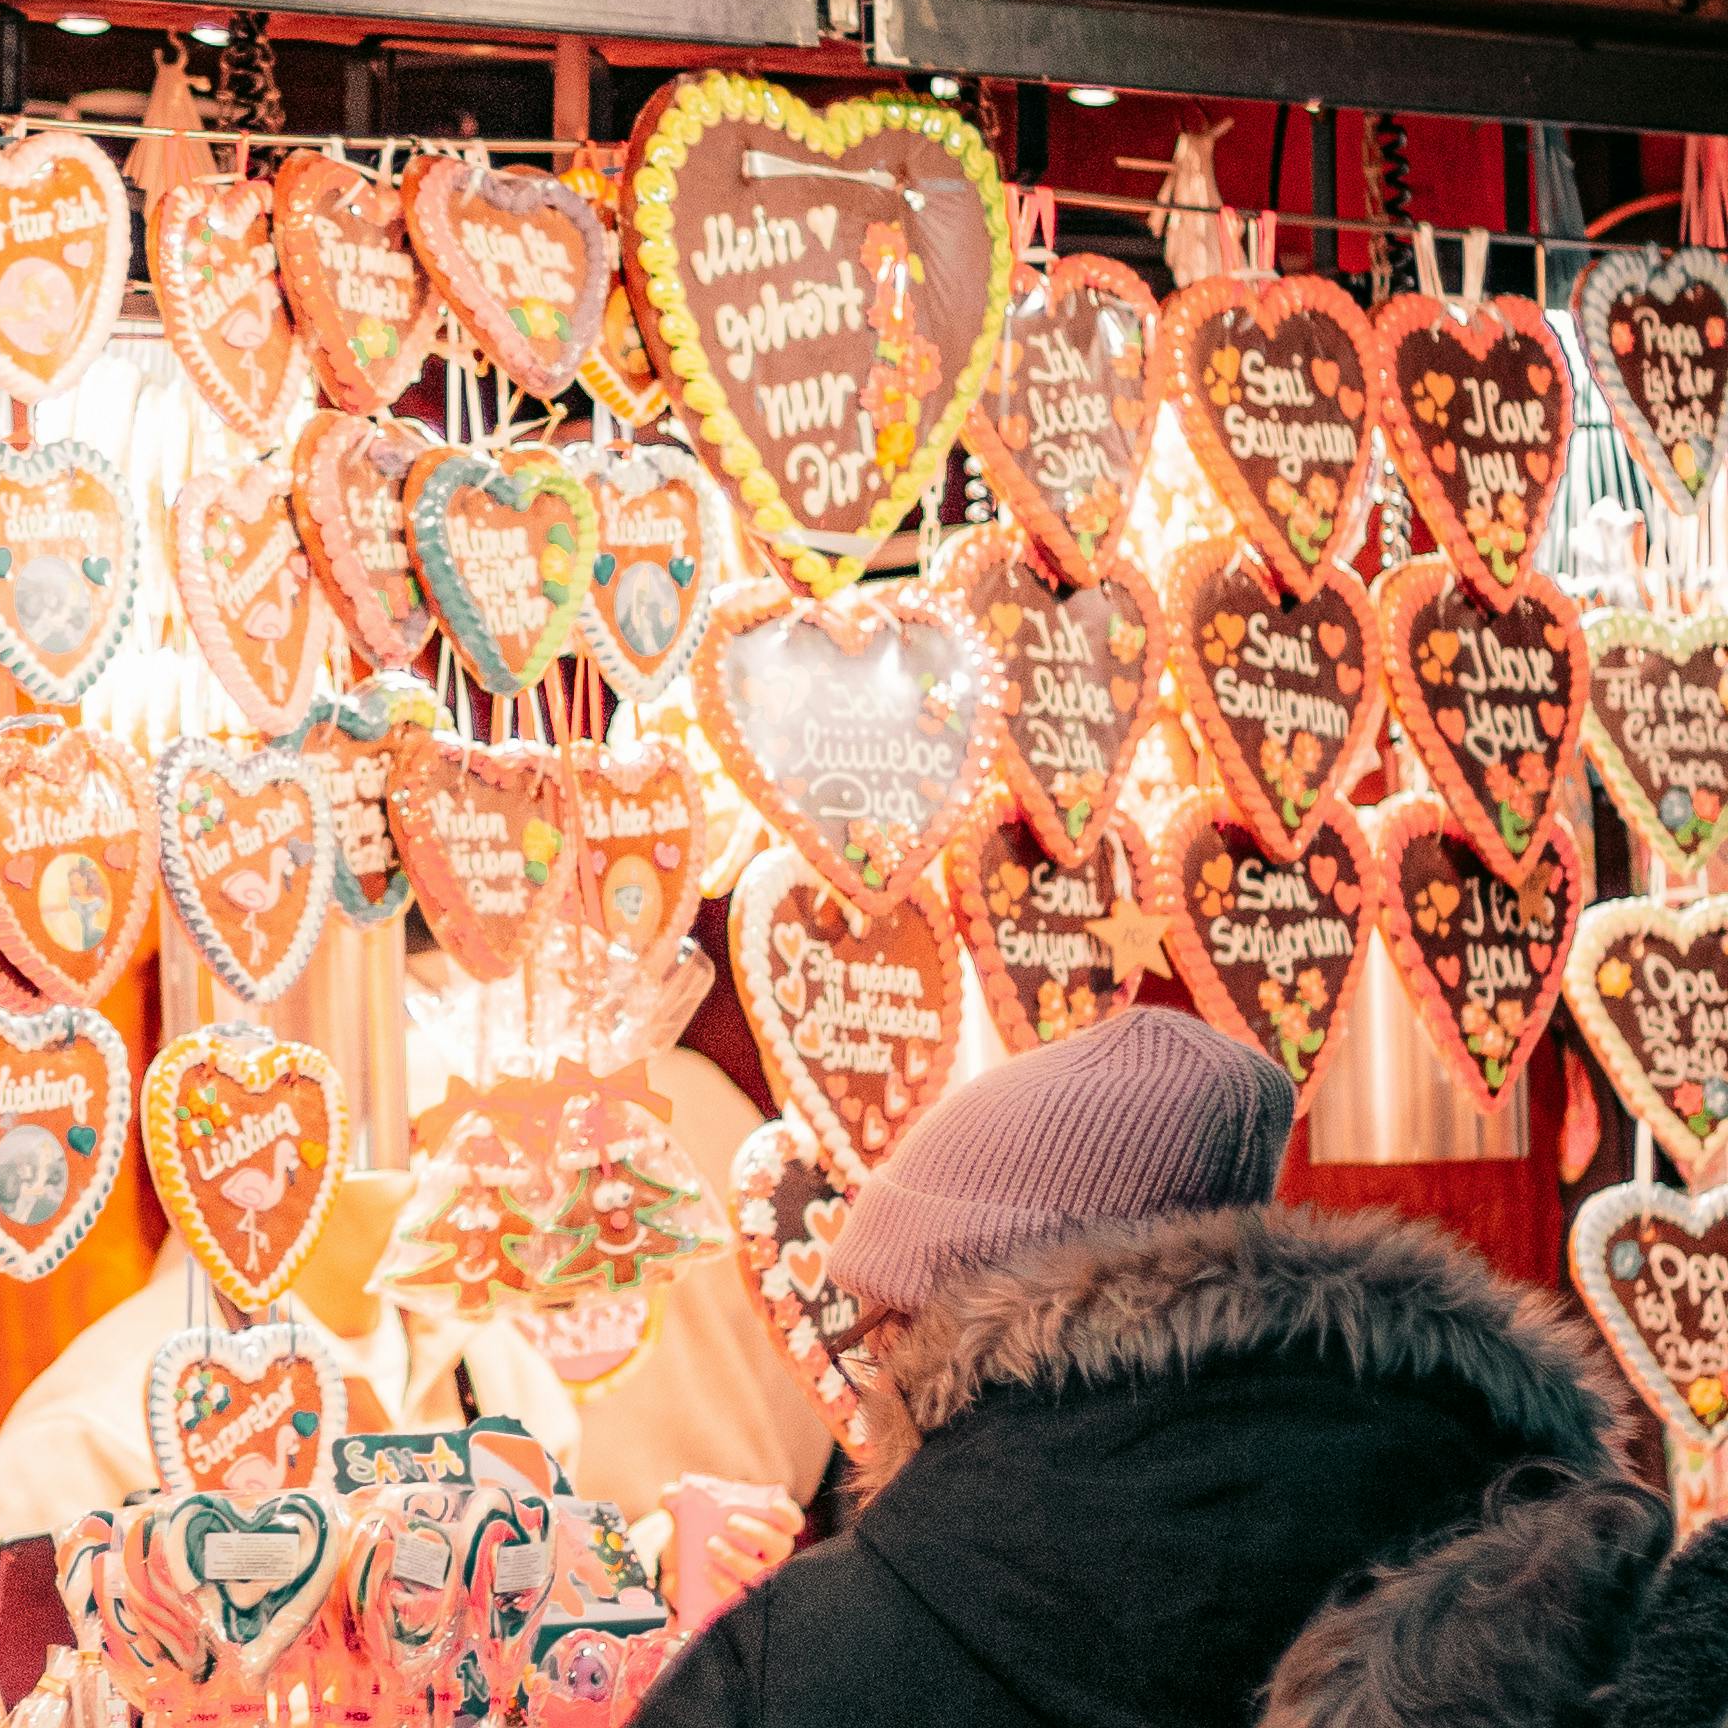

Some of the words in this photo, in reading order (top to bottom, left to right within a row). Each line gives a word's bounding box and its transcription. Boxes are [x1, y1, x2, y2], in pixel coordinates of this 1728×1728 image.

[689, 204, 805, 284] Mein
[716, 261, 865, 380] gehört
[1633, 307, 1703, 367] Papa
[1029, 327, 1092, 382] Ich
[1241, 349, 1315, 408] Seni
[1642, 355, 1675, 401] ist
[756, 372, 857, 439] nur
[1029, 388, 1111, 445] liebe
[1033, 442, 1113, 488] Dich
[1464, 451, 1527, 510] you
[1023, 603, 1092, 665] Ich
[1247, 612, 1319, 679] Seni
[1023, 662, 1115, 723] liebe
[1660, 671, 1722, 716] den
[1028, 718, 1106, 772] Dich
[1462, 701, 1539, 761] you
[808, 772, 927, 821] Dich
[1032, 863, 1105, 916] Seni
[1238, 859, 1316, 911] Seni
[1466, 943, 1532, 1004] you
[1642, 953, 1727, 1012] Opa
[191, 1101, 301, 1181] Liebling
[184, 1374, 297, 1478] Superstar
[344, 1438, 466, 1489] SANTA
